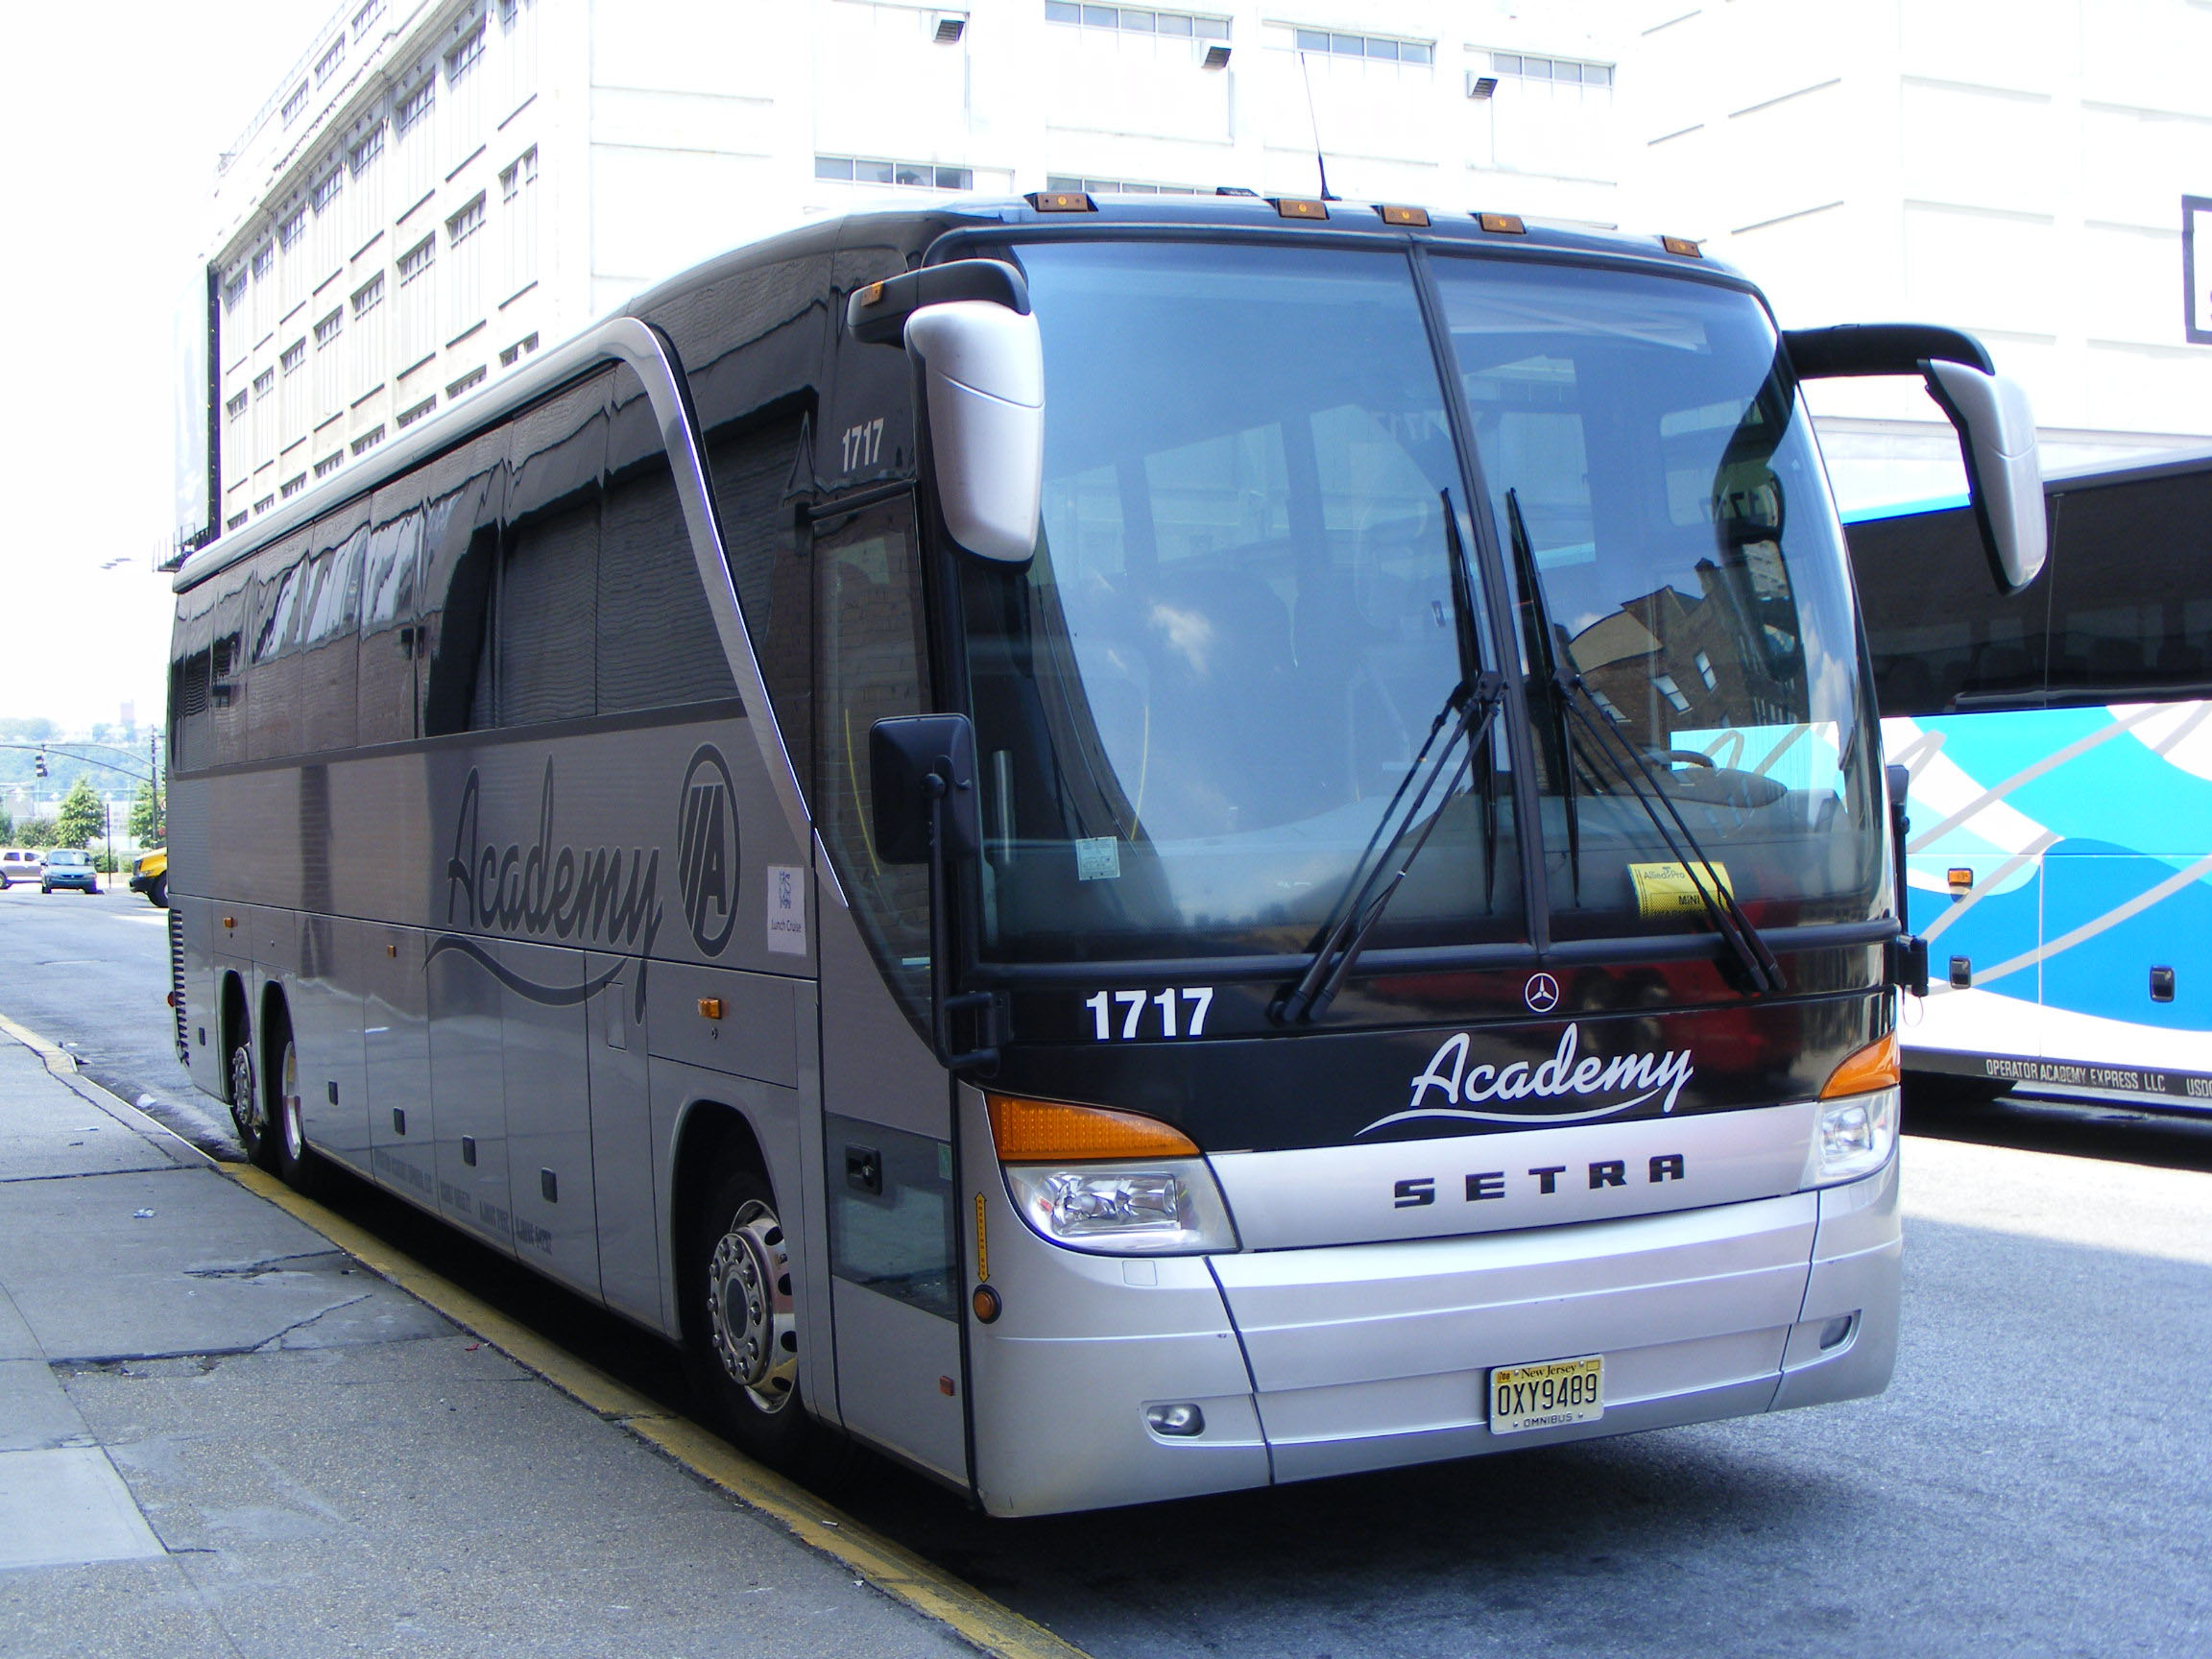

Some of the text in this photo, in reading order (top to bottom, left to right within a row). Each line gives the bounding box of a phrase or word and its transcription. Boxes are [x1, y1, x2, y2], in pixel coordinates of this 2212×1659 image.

[842, 418, 884, 473] 1717
[446, 754, 663, 1026] Academy
[1678, 895, 1700, 905] MINI
[771, 919, 802, 933] Lunch Cruise
[1086, 987, 1214, 1040] 1717
[1410, 1022, 1695, 1114] Academy
[1985, 1059, 2039, 1080] OPERATOR
[2040, 1064, 2086, 1084] ACADEMY
[2089, 1069, 2139, 1090] EXPRESS
[2144, 1072, 2166, 1093] LLC
[1394, 1153, 1685, 1209] SETRA
[1521, 1368, 1544, 1380] New
[1546, 1364, 1577, 1378] Jersey
[1524, 1412, 1573, 1429] OMNIBUS
